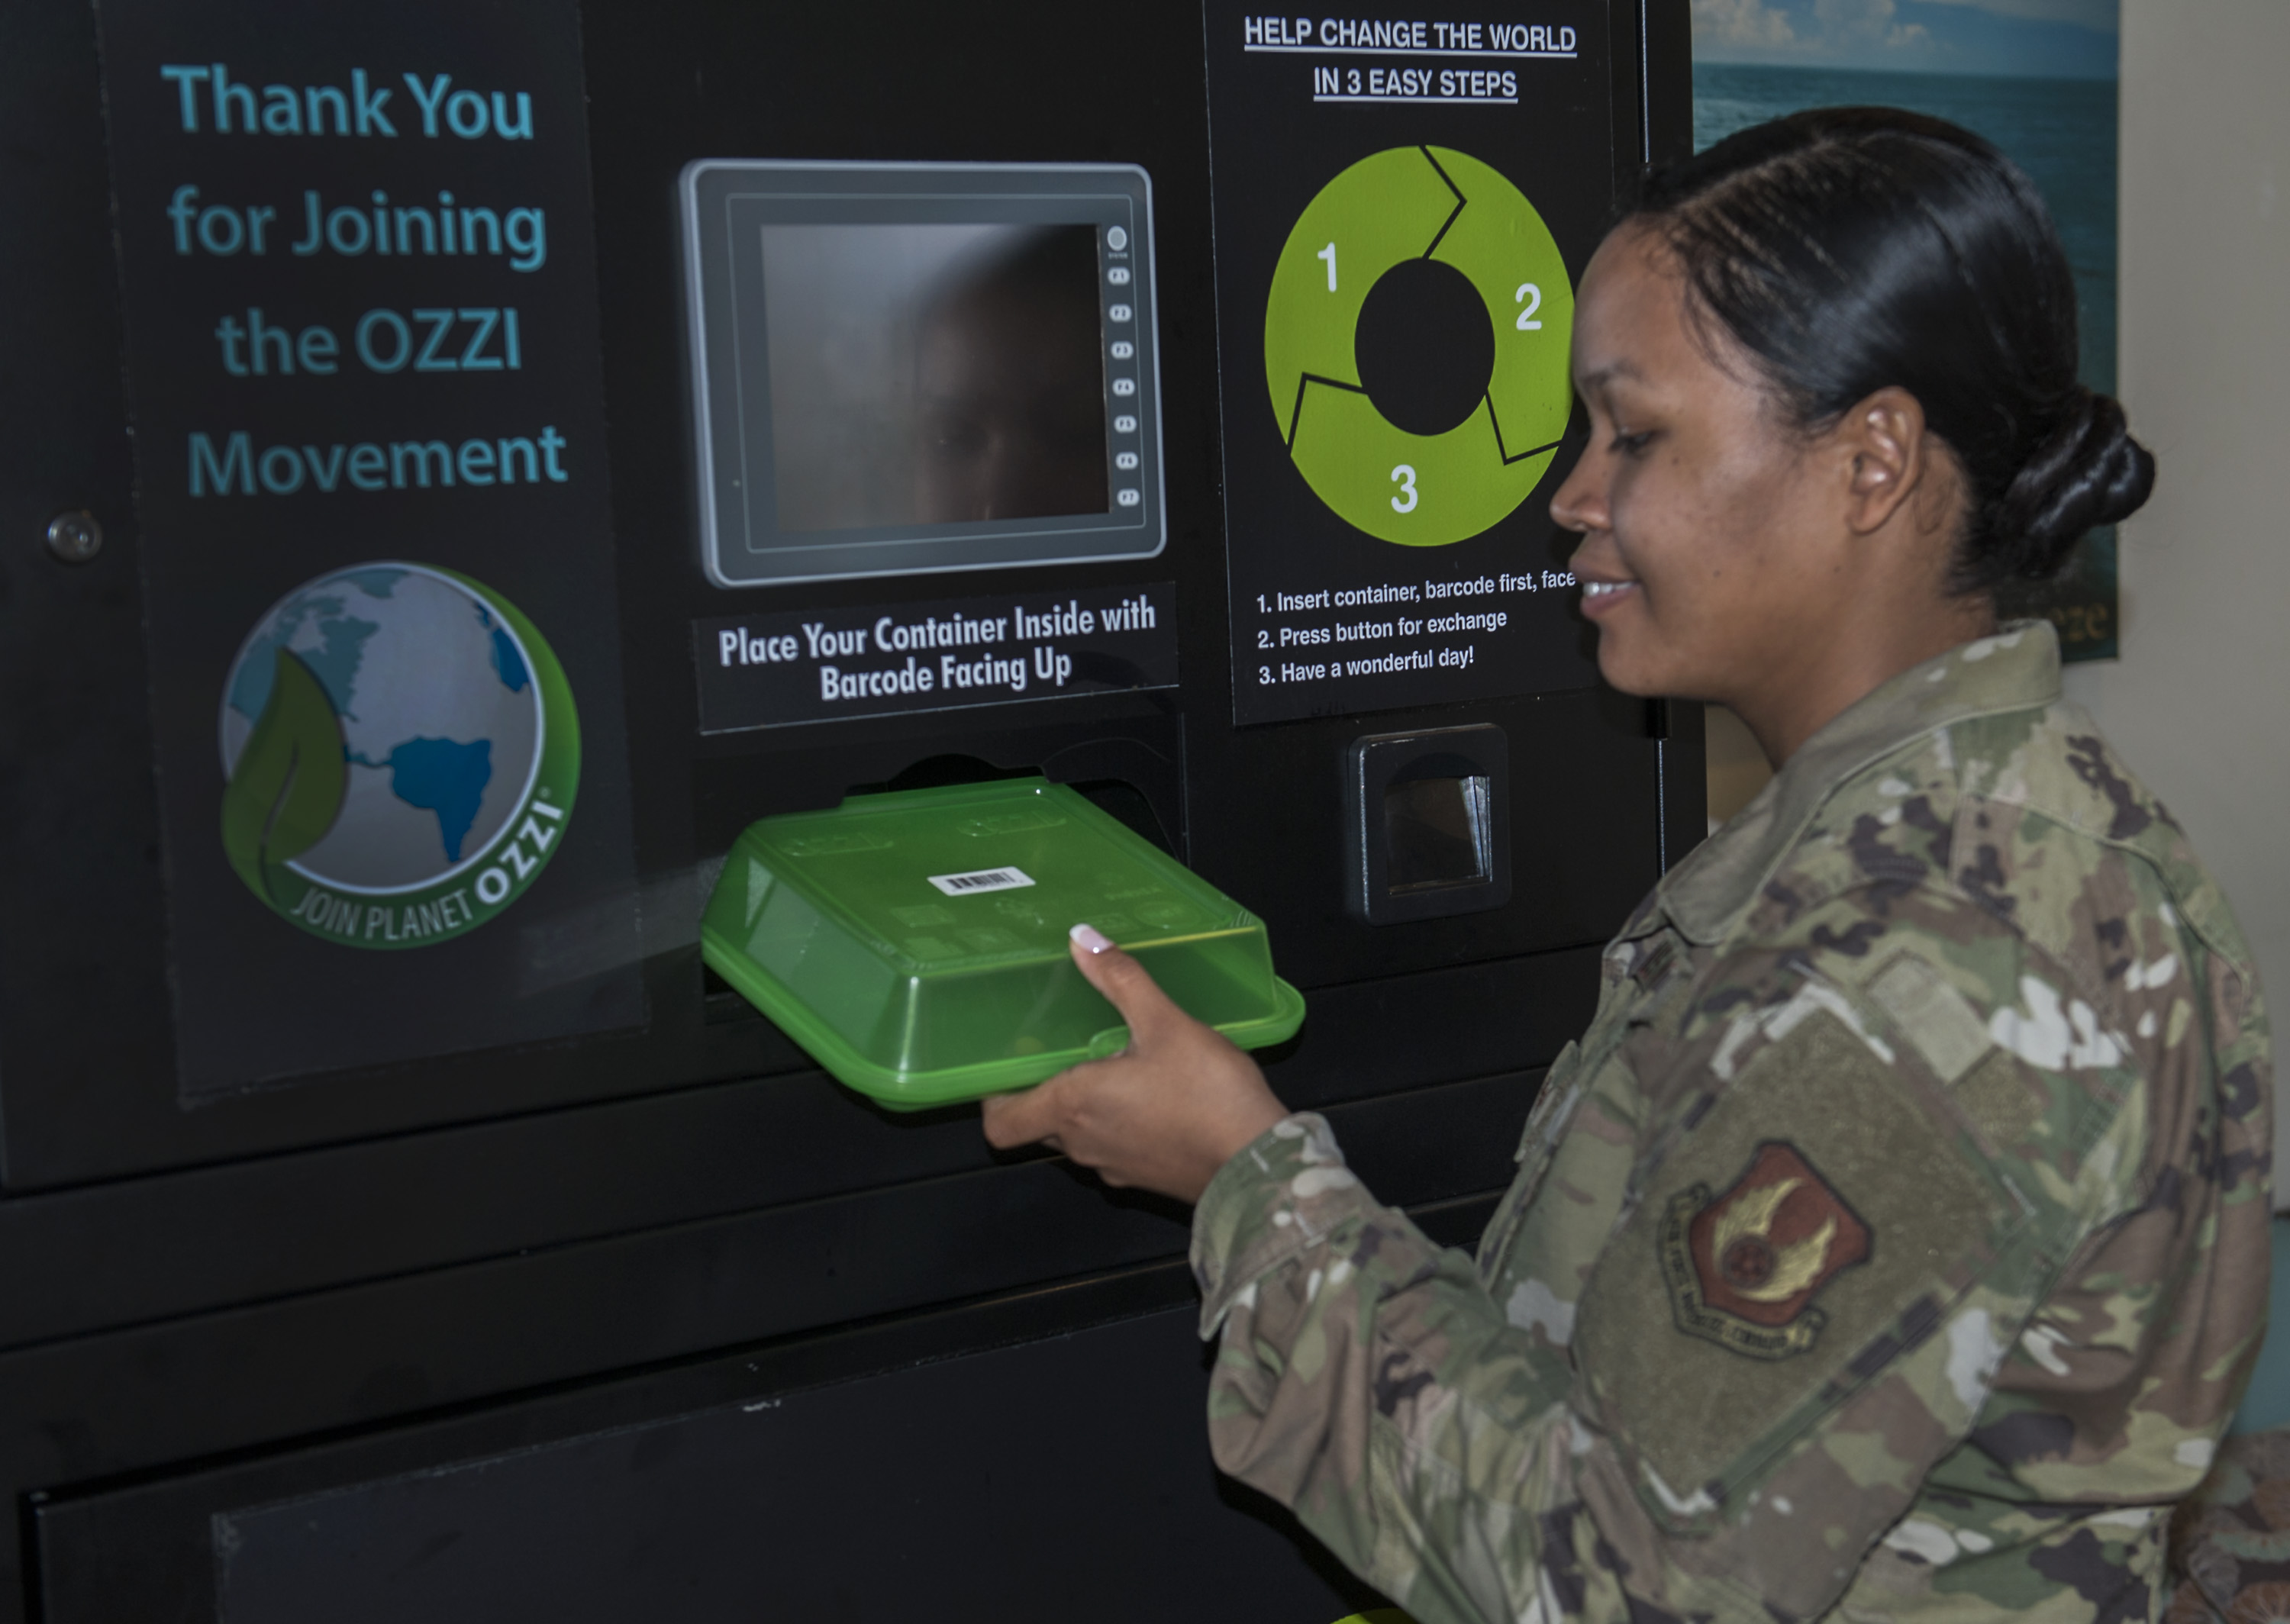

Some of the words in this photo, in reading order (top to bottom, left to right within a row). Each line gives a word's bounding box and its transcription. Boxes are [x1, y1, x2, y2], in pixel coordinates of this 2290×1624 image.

[1244, 16, 1311, 45] HELP
[1320, 18, 1427, 48] CHANGE
[1434, 22, 1482, 50] THE
[1489, 24, 1577, 52] WORLD
[160, 63, 398, 137] Thank
[402, 72, 533, 140] You
[1314, 67, 1339, 95] IN
[1347, 69, 1361, 95] 3
[1369, 69, 1432, 96] EASY
[1440, 71, 1518, 98] STEPS
[166, 184, 276, 255] for
[292, 189, 547, 272] Joining
[1318, 242, 1337, 293] 1
[1515, 283, 1542, 330] 2
[214, 306, 339, 375] the
[354, 307, 521, 372] OZZI
[188, 425, 568, 497] Movement
[1391, 463, 1418, 515] 3
[1256, 594, 1272, 614] 1.
[1277, 589, 1330, 612] Insert
[1334, 585, 1421, 607] container,
[1425, 575, 1495, 600] barcode
[1499, 572, 1537, 592] first,
[1541, 569, 1576, 591] face
[718, 627, 798, 666] Place
[802, 623, 867, 659] Your
[875, 612, 1007, 652] Container
[1014, 600, 1095, 640] Inside
[1101, 595, 1156, 633] with
[1257, 630, 1275, 649] 2.
[1279, 626, 1330, 648] Press
[1336, 620, 1393, 643] button
[1398, 617, 1422, 636] for
[1427, 612, 1508, 633] exchange
[820, 657, 934, 701] Barcode
[940, 652, 1027, 691] Facing
[1034, 646, 1072, 686] Up
[1259, 666, 1276, 685] 3.
[1281, 662, 1326, 683] Have
[1330, 662, 1341, 678] a
[1347, 650, 1434, 675] wonderful
[1438, 646, 1474, 669] day!
[291, 887, 363, 936] JOIN
[365, 888, 473, 940] PLANET
